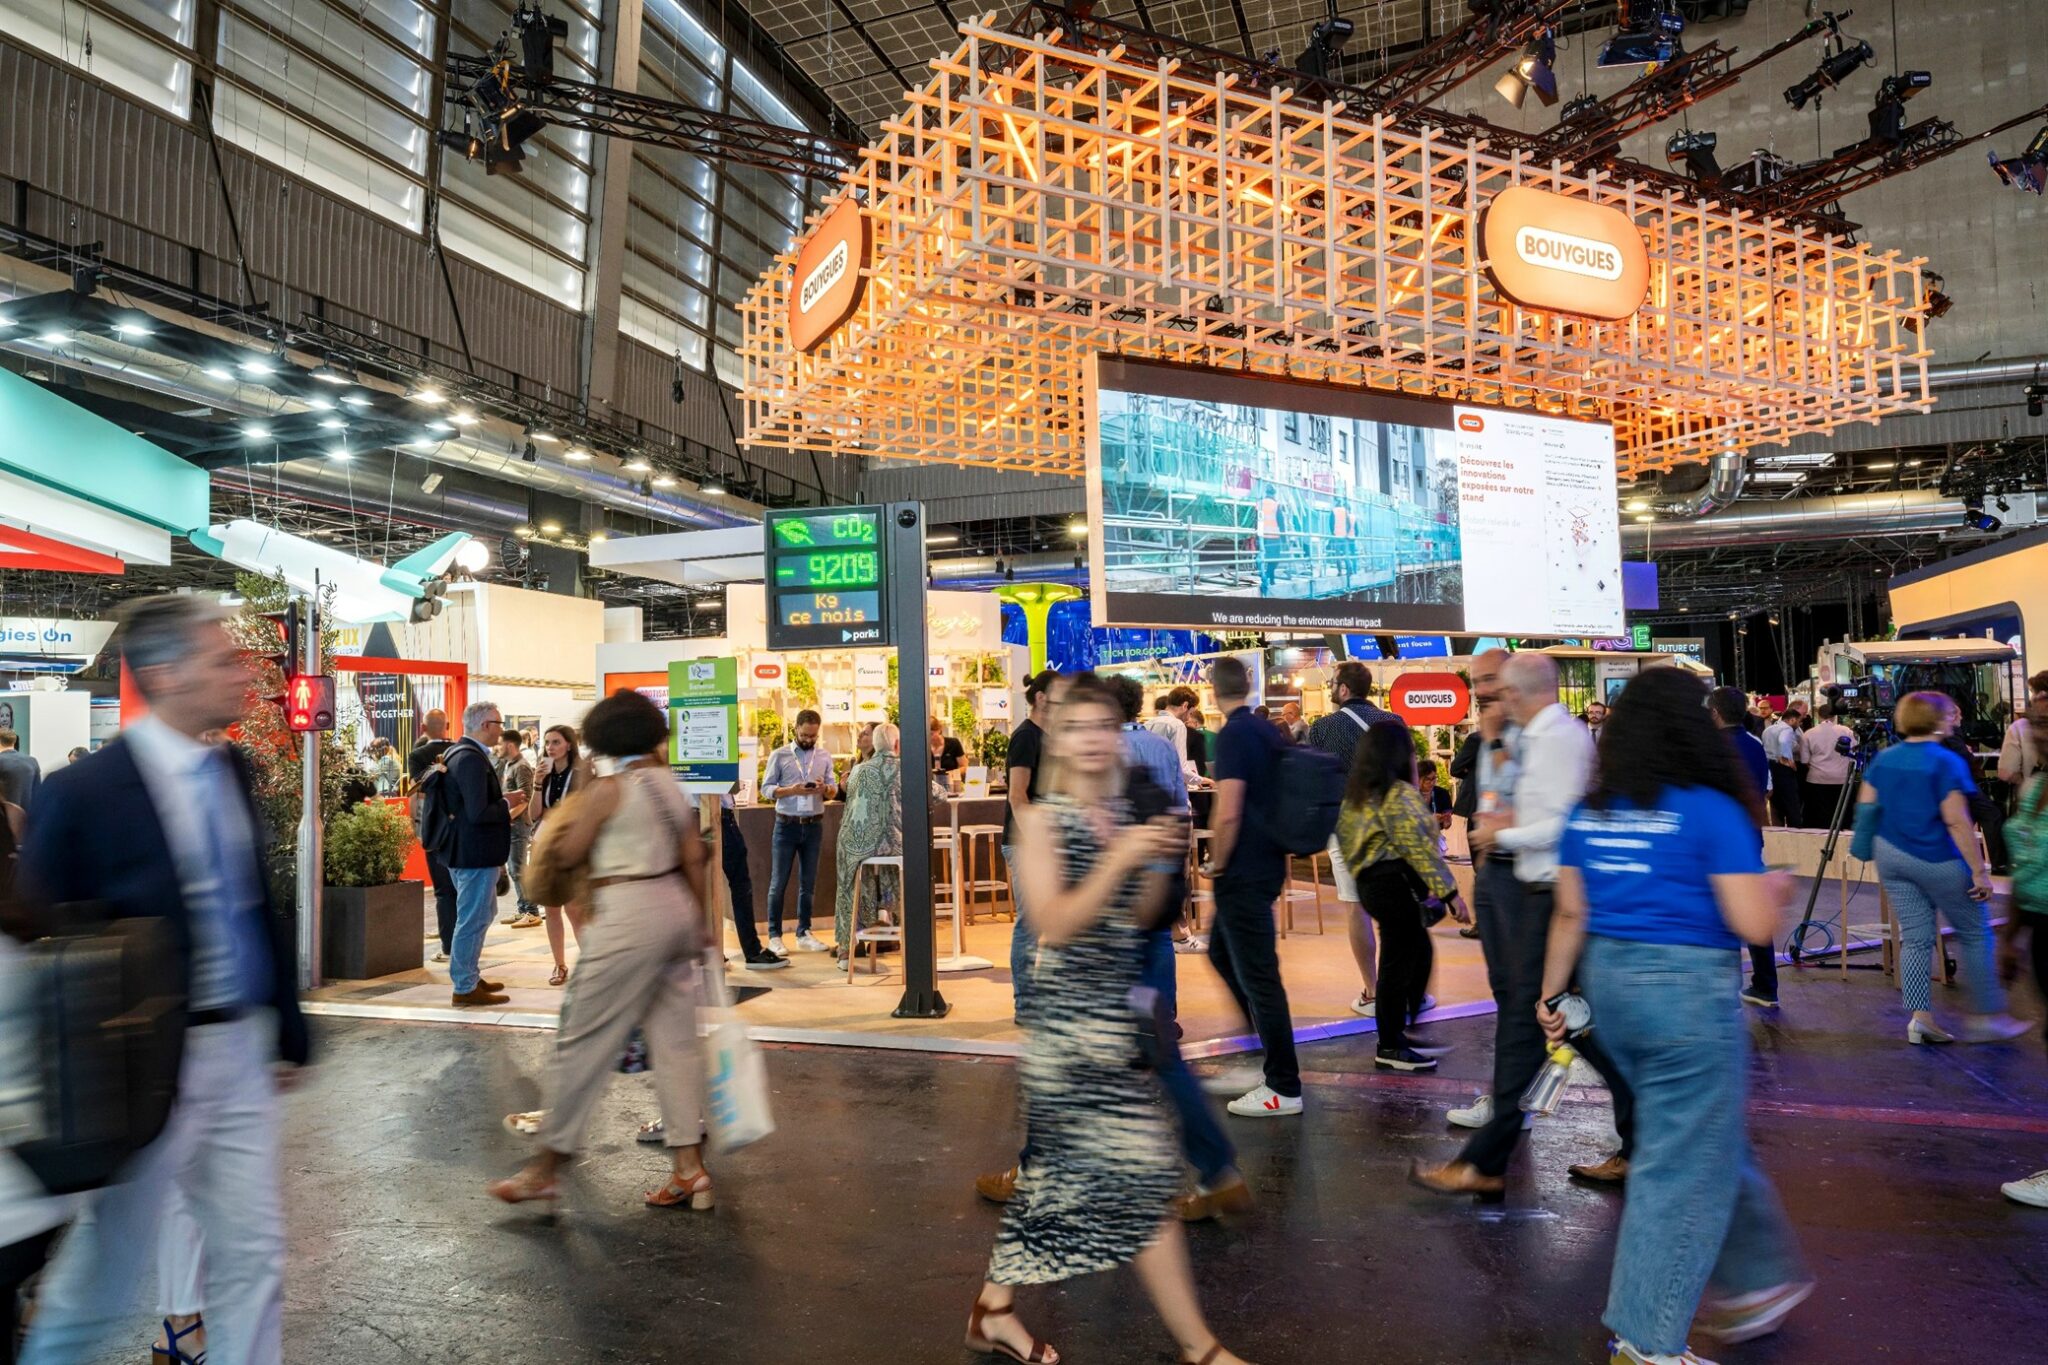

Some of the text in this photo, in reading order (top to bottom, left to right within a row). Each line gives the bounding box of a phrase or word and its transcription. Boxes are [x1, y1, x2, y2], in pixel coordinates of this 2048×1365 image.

[1524, 234, 1615, 272] BOUYGUES
[803, 249, 844, 306] BOUYGUES
[1503, 460, 1514, 470] les
[1460, 467, 1506, 481] innovations
[1500, 486, 1513, 494] sur
[1513, 487, 1535, 496] notre
[1462, 494, 1485, 503] stand
[809, 552, 874, 585] 9209
[789, 612, 812, 625] ce
[1212, 612, 1381, 629] We are reducing the environmental impact
[43, 628, 72, 642] On
[1103, 646, 1168, 658] TECH FOR GOOD
[1657, 643, 1700, 653] FUTURE OF
[364, 692, 407, 703] INCLUSIVE
[1408, 693, 1453, 704] BOUYGUES
[371, 708, 414, 719] TOGETHER
